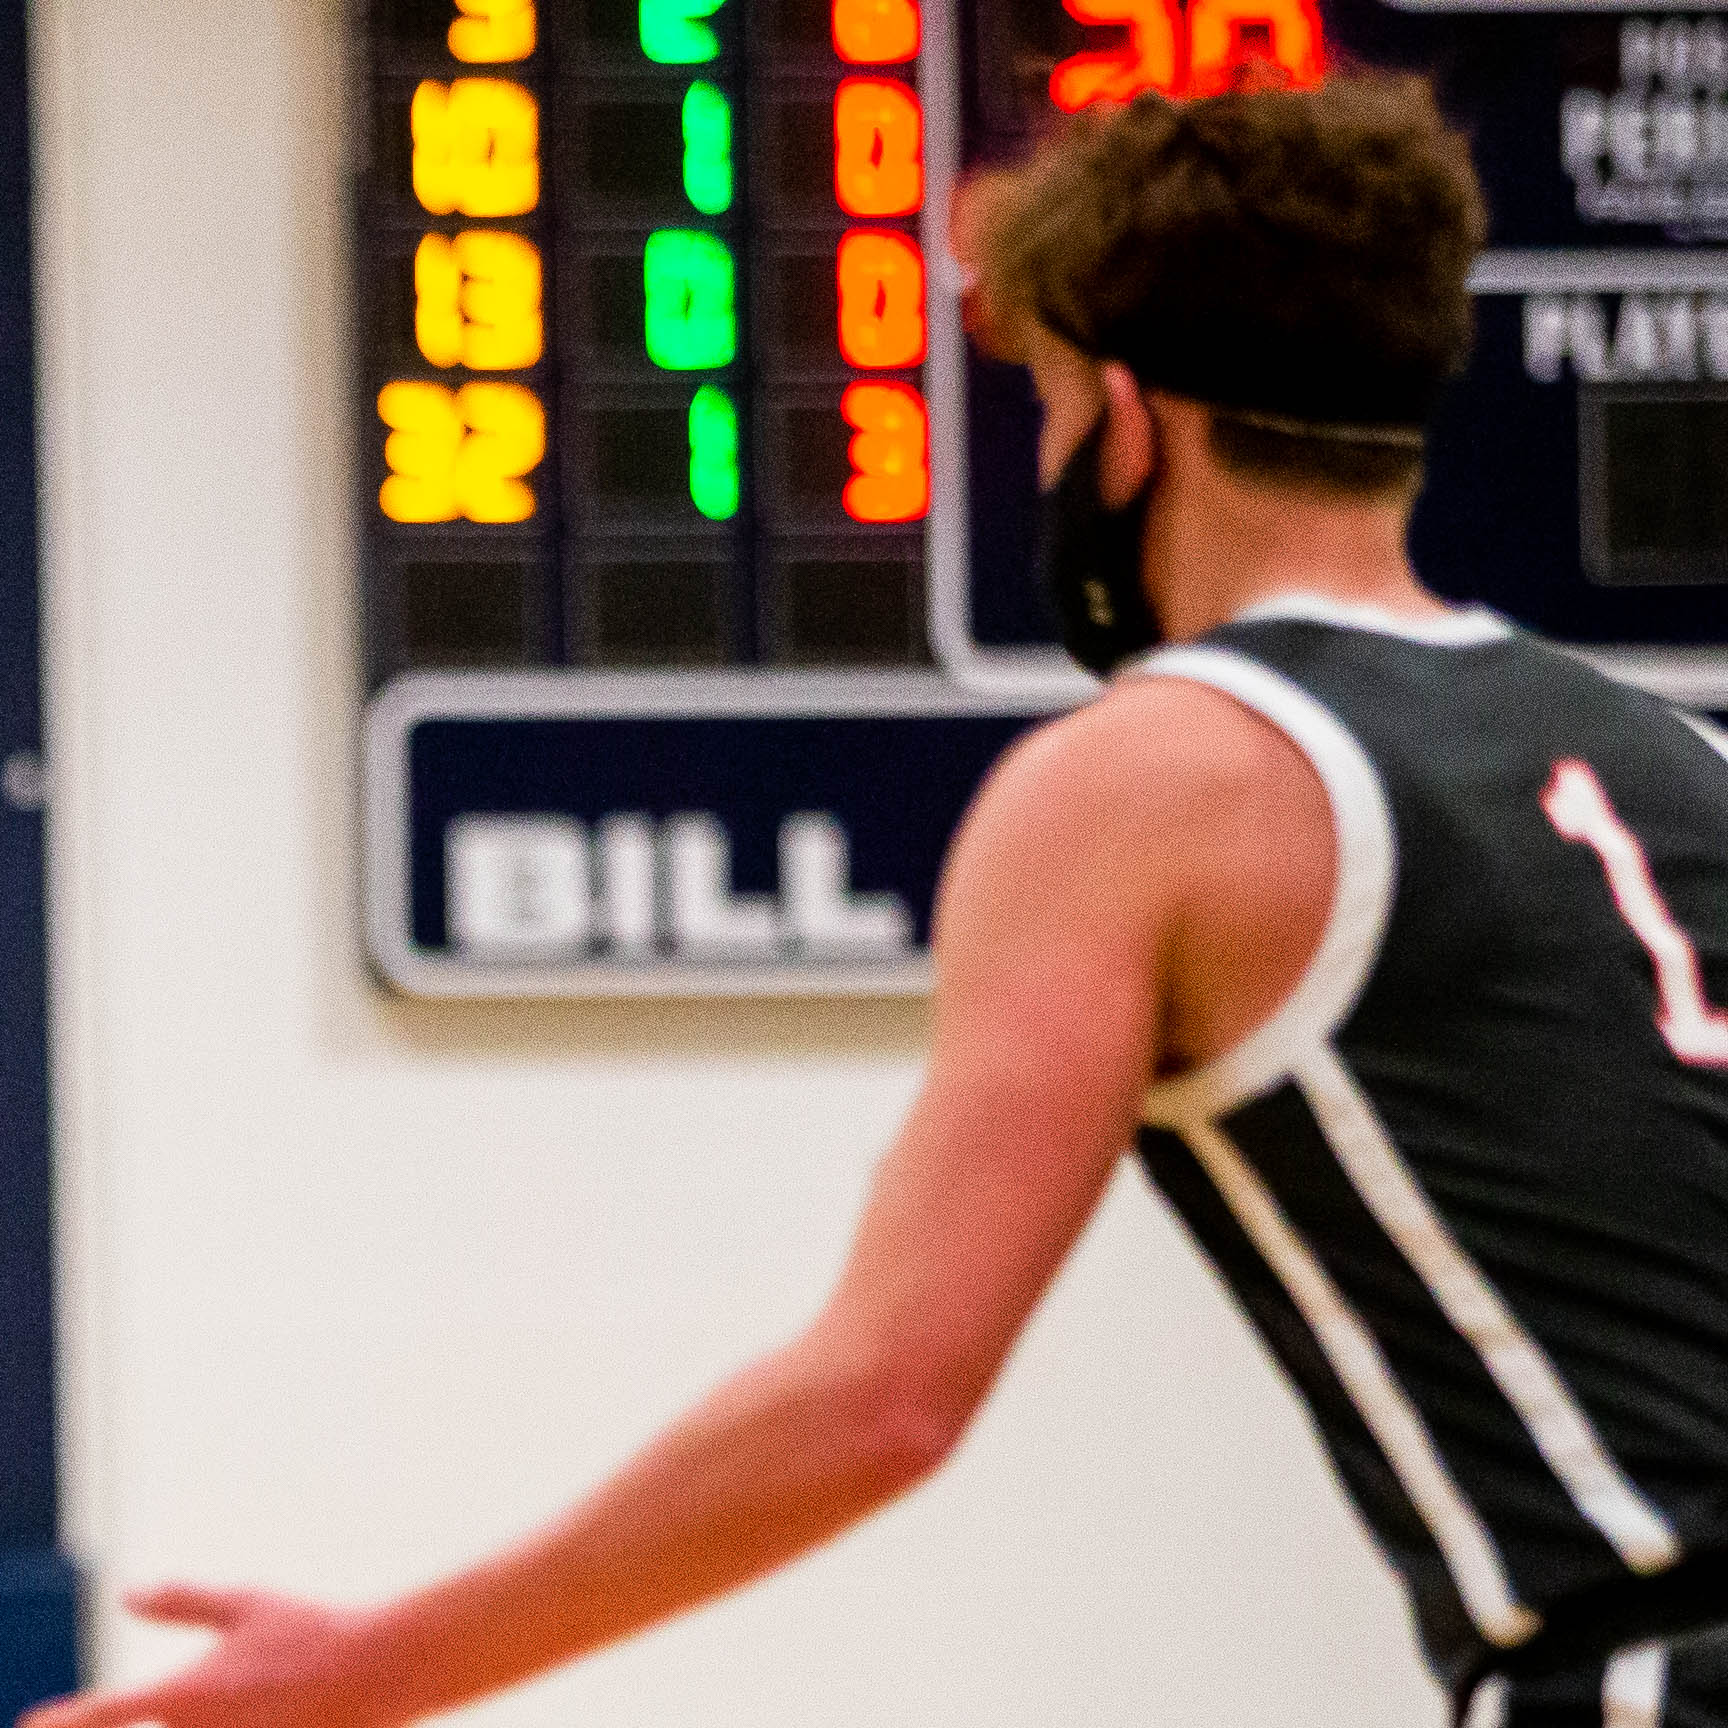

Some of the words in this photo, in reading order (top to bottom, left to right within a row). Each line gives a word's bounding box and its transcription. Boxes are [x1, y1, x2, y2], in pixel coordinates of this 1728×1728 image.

[411, 77, 540, 217] 10
[682, 80, 734, 215] 1
[833, 75, 925, 219] 0
[414, 228, 544, 370] 13
[644, 226, 736, 371] 0
[836, 226, 928, 371] 0
[377, 379, 546, 523] 32
[689, 383, 740, 521] 1
[839, 378, 931, 524] 3
[444, 810, 915, 961] BILL
